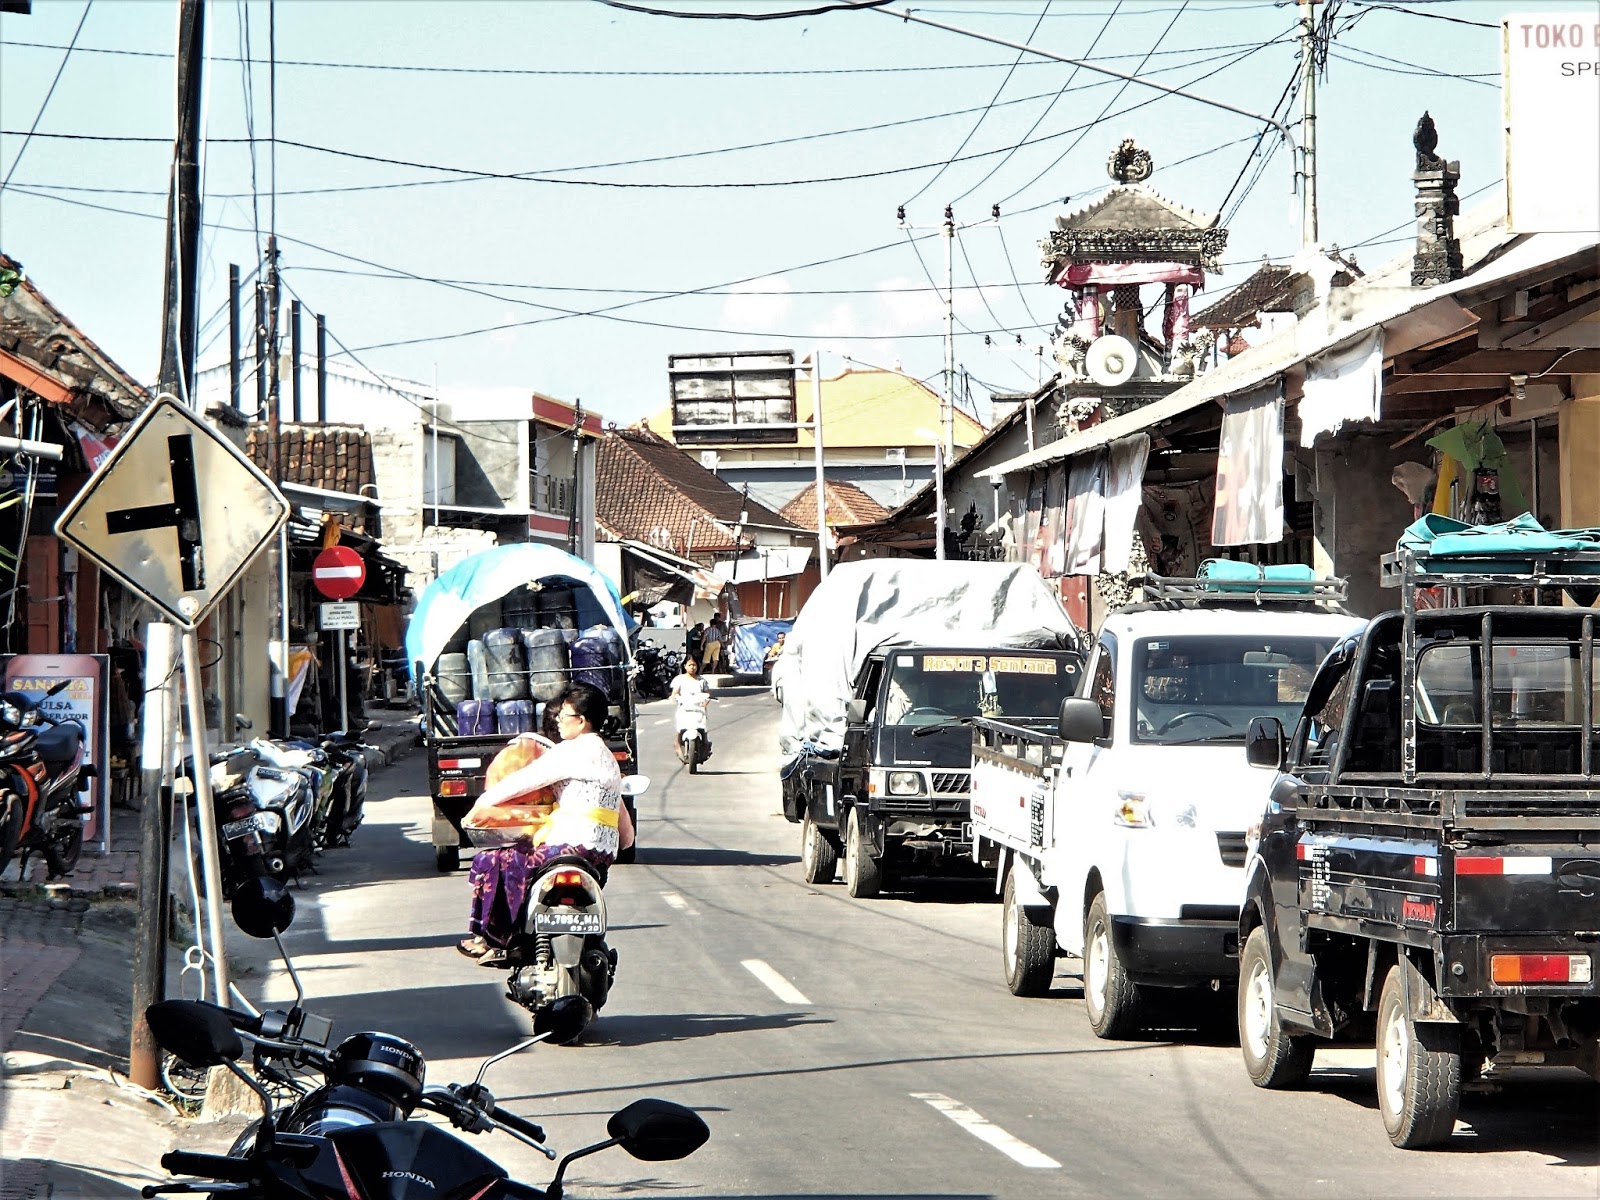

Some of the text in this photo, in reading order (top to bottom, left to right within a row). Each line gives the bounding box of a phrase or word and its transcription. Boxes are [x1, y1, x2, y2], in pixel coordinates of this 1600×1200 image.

[1520, 24, 1583, 48] TOKO
[39, 702, 72, 710] ULSA
[538, 914, 551, 924] DK
[380, 1045, 414, 1062] HONDA
[382, 1171, 436, 1190] HONDA
